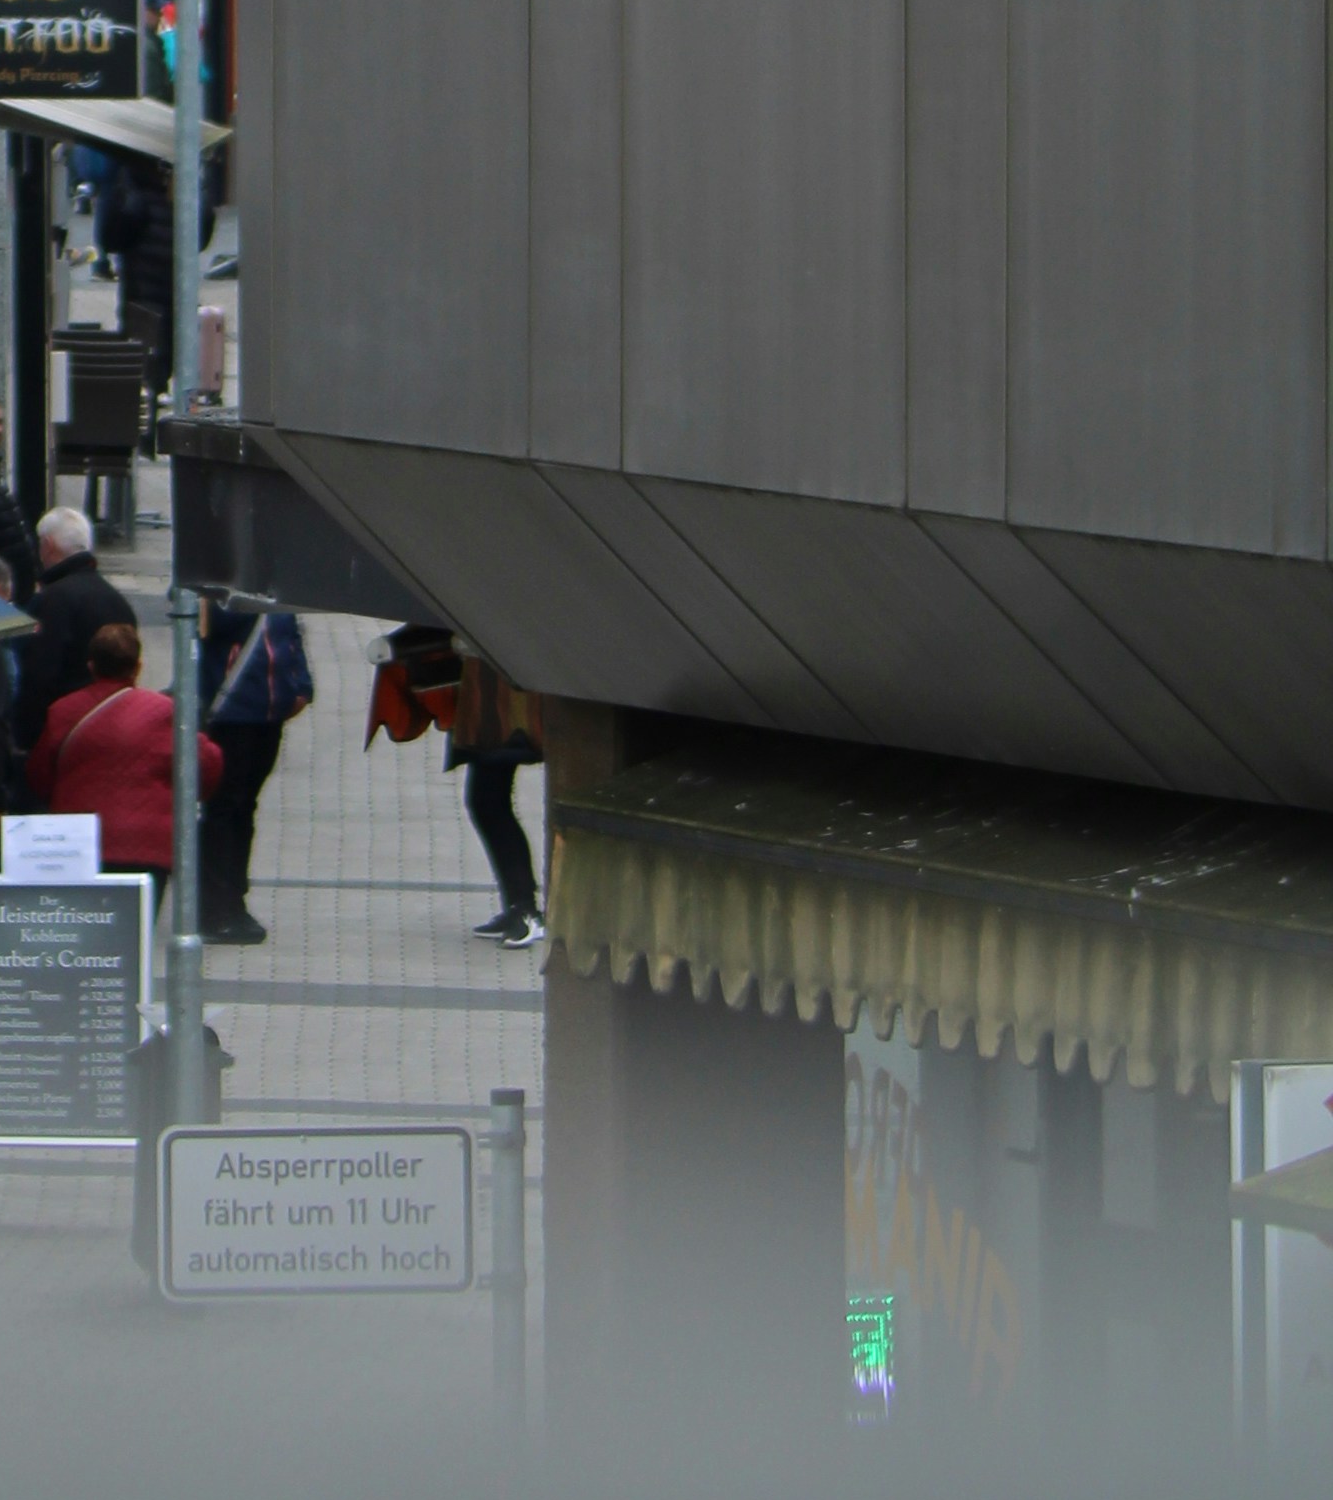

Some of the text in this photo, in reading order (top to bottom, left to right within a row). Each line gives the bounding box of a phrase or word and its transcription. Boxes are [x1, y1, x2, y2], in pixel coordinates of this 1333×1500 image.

[20, 67, 81, 85] Piercing
[20, 928, 78, 943] Koblenz
[57, 949, 121, 968] Corner
[215, 1151, 424, 1186] Absperrpoller
[203, 1197, 436, 1226] fährt um 11 Uhr
[187, 1244, 452, 1273] automatisch hoch
